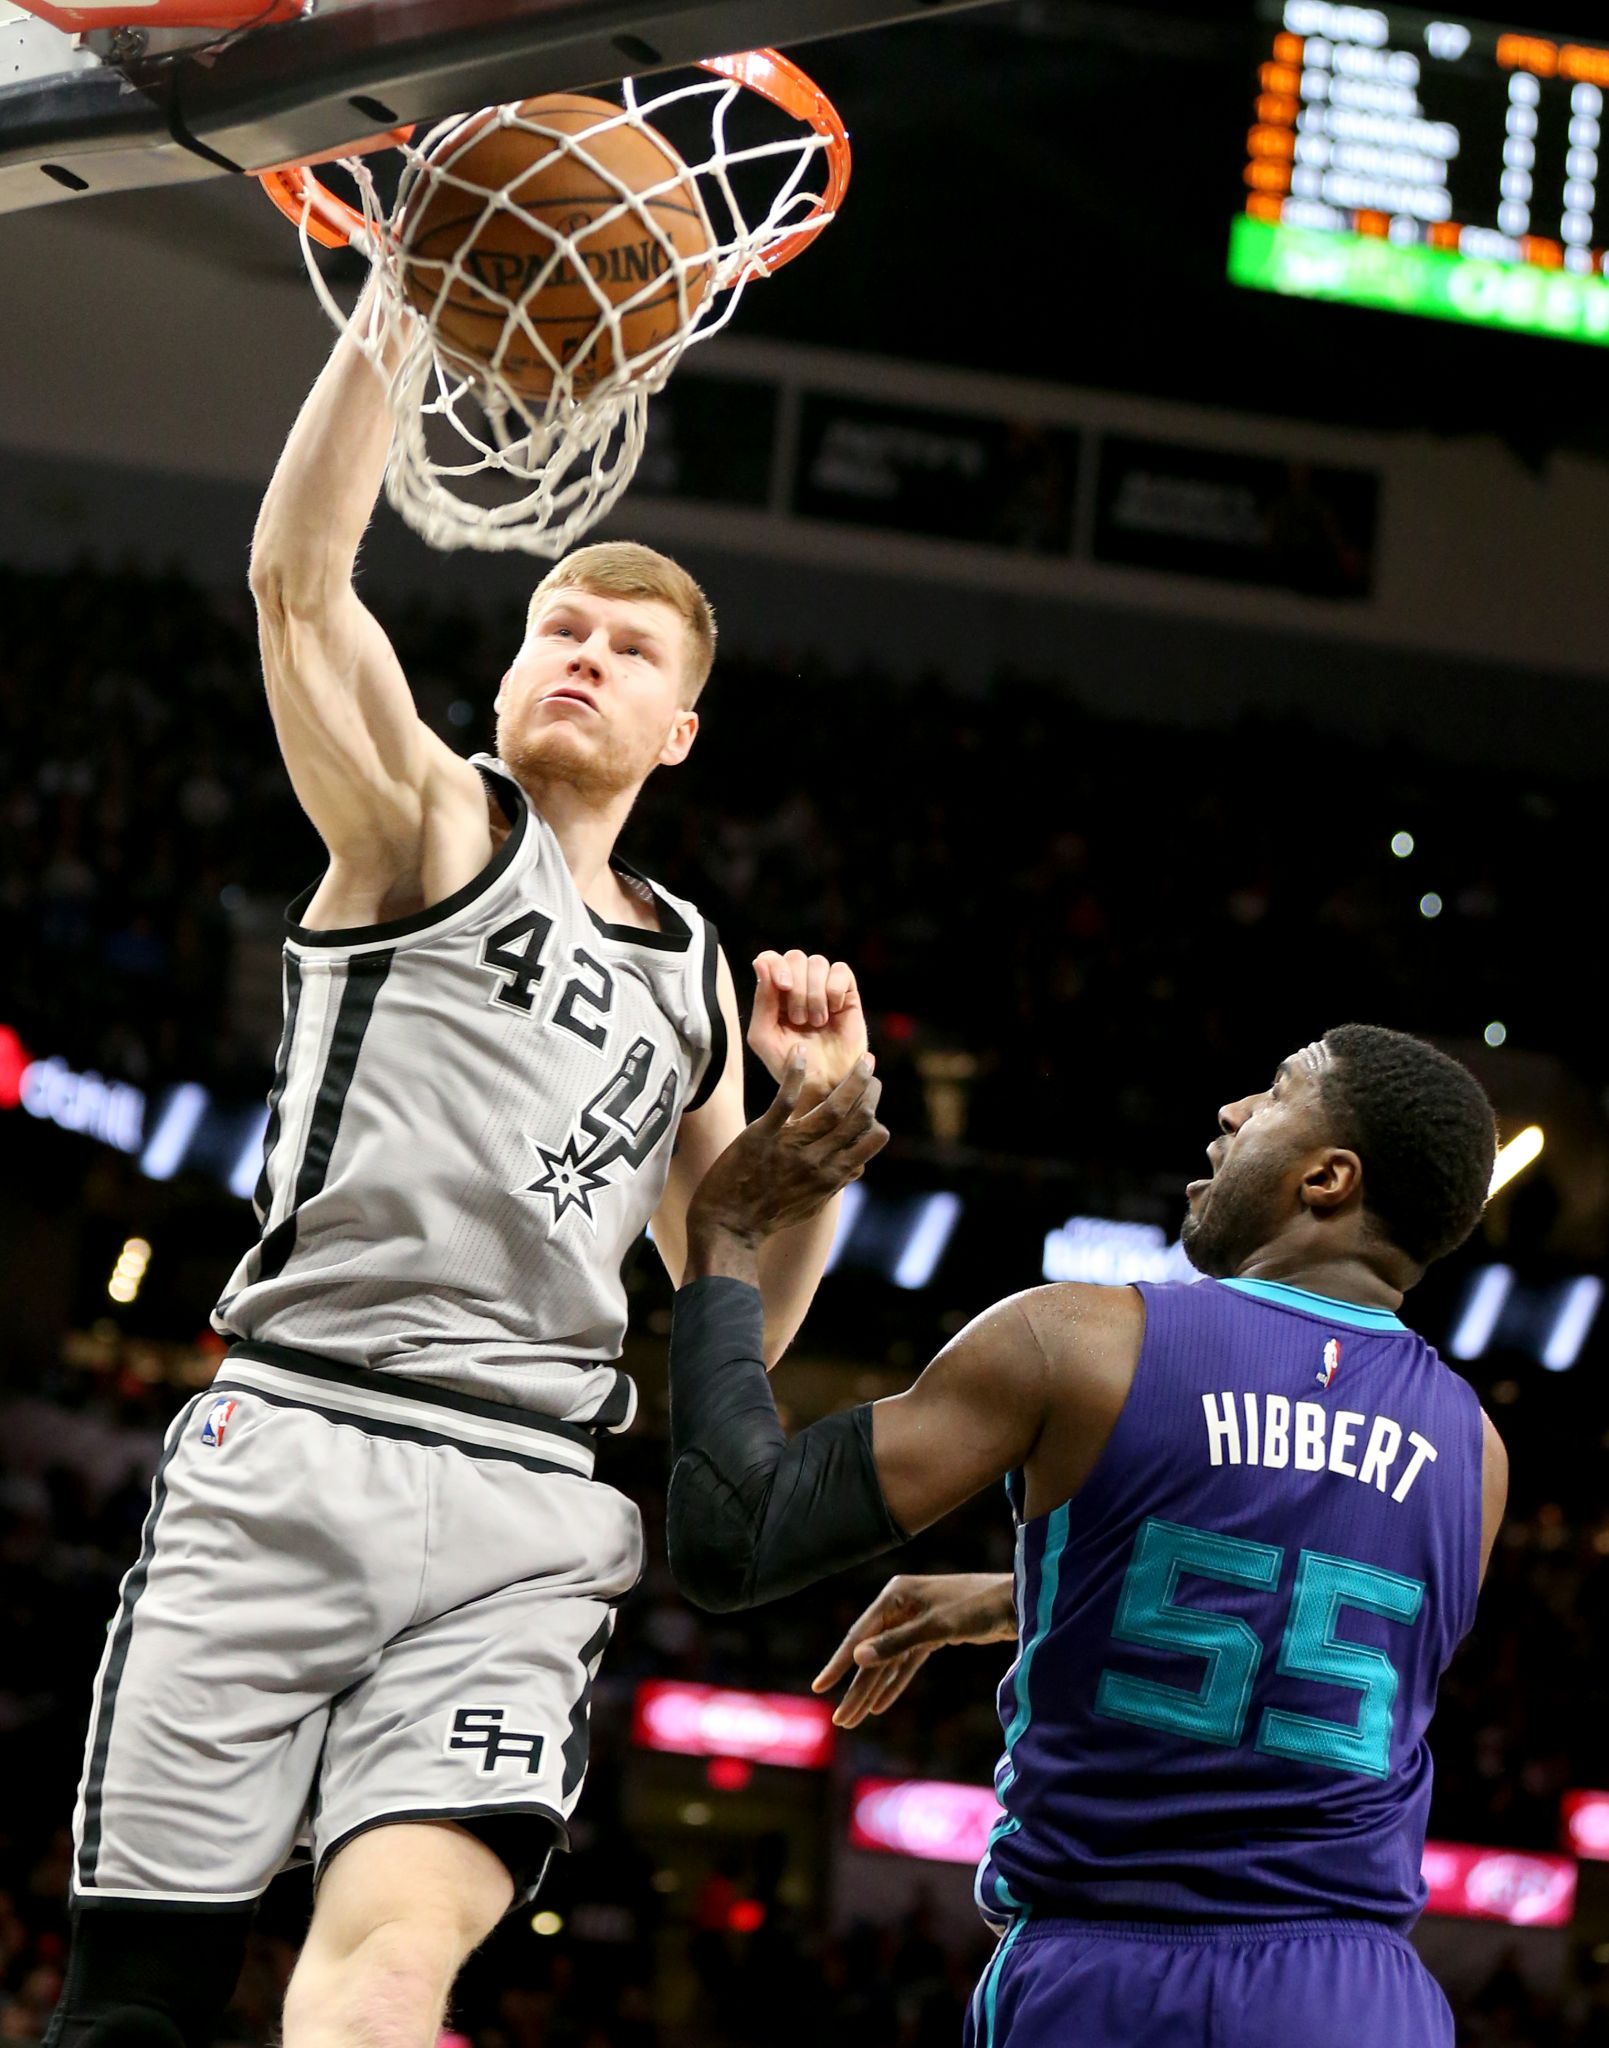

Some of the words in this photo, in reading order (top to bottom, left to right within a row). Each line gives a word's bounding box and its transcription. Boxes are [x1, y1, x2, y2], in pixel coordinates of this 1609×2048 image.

[481, 908, 614, 1055] 42
[1201, 1391, 1438, 1504] HIBBERT
[1094, 1516, 1427, 1782] 55
